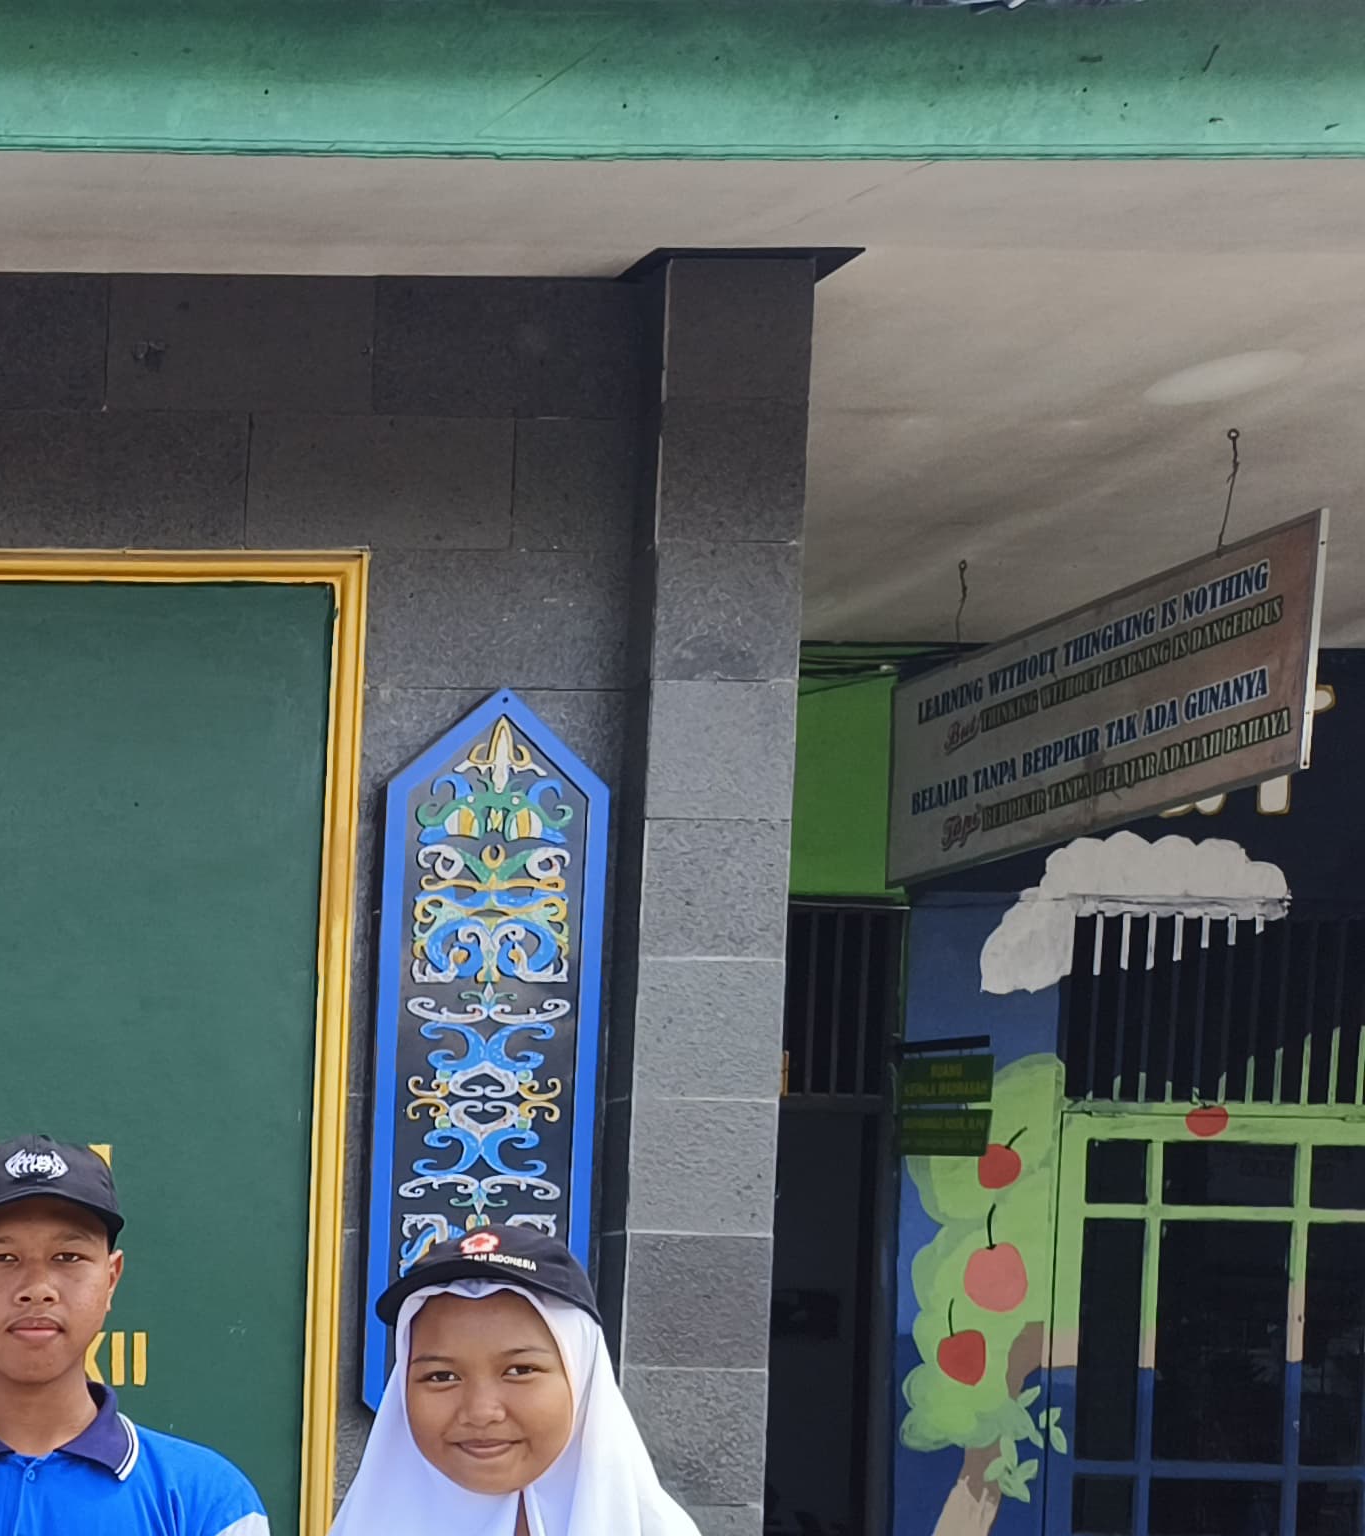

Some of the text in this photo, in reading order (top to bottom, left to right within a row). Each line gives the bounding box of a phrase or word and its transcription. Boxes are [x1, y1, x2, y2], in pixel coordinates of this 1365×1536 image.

[918, 560, 1269, 725] LEARNING WITHOUT THINGKING IS NOTHING
[1101, 638, 1170, 688] LEARNING
[1172, 631, 1189, 661] IS
[1189, 595, 1285, 655] DANGEROUS
[911, 667, 1268, 816] BELAJAR TANPA BERPIKIR TAK ADA GUNANYA
[1047, 772, 1092, 811] TANPA
[1092, 751, 1158, 797] BELAJAR
[1157, 728, 1223, 775] ADALAH
[1223, 706, 1291, 755] BAHAYA
[488, 1252, 538, 1272] INDONESIA
